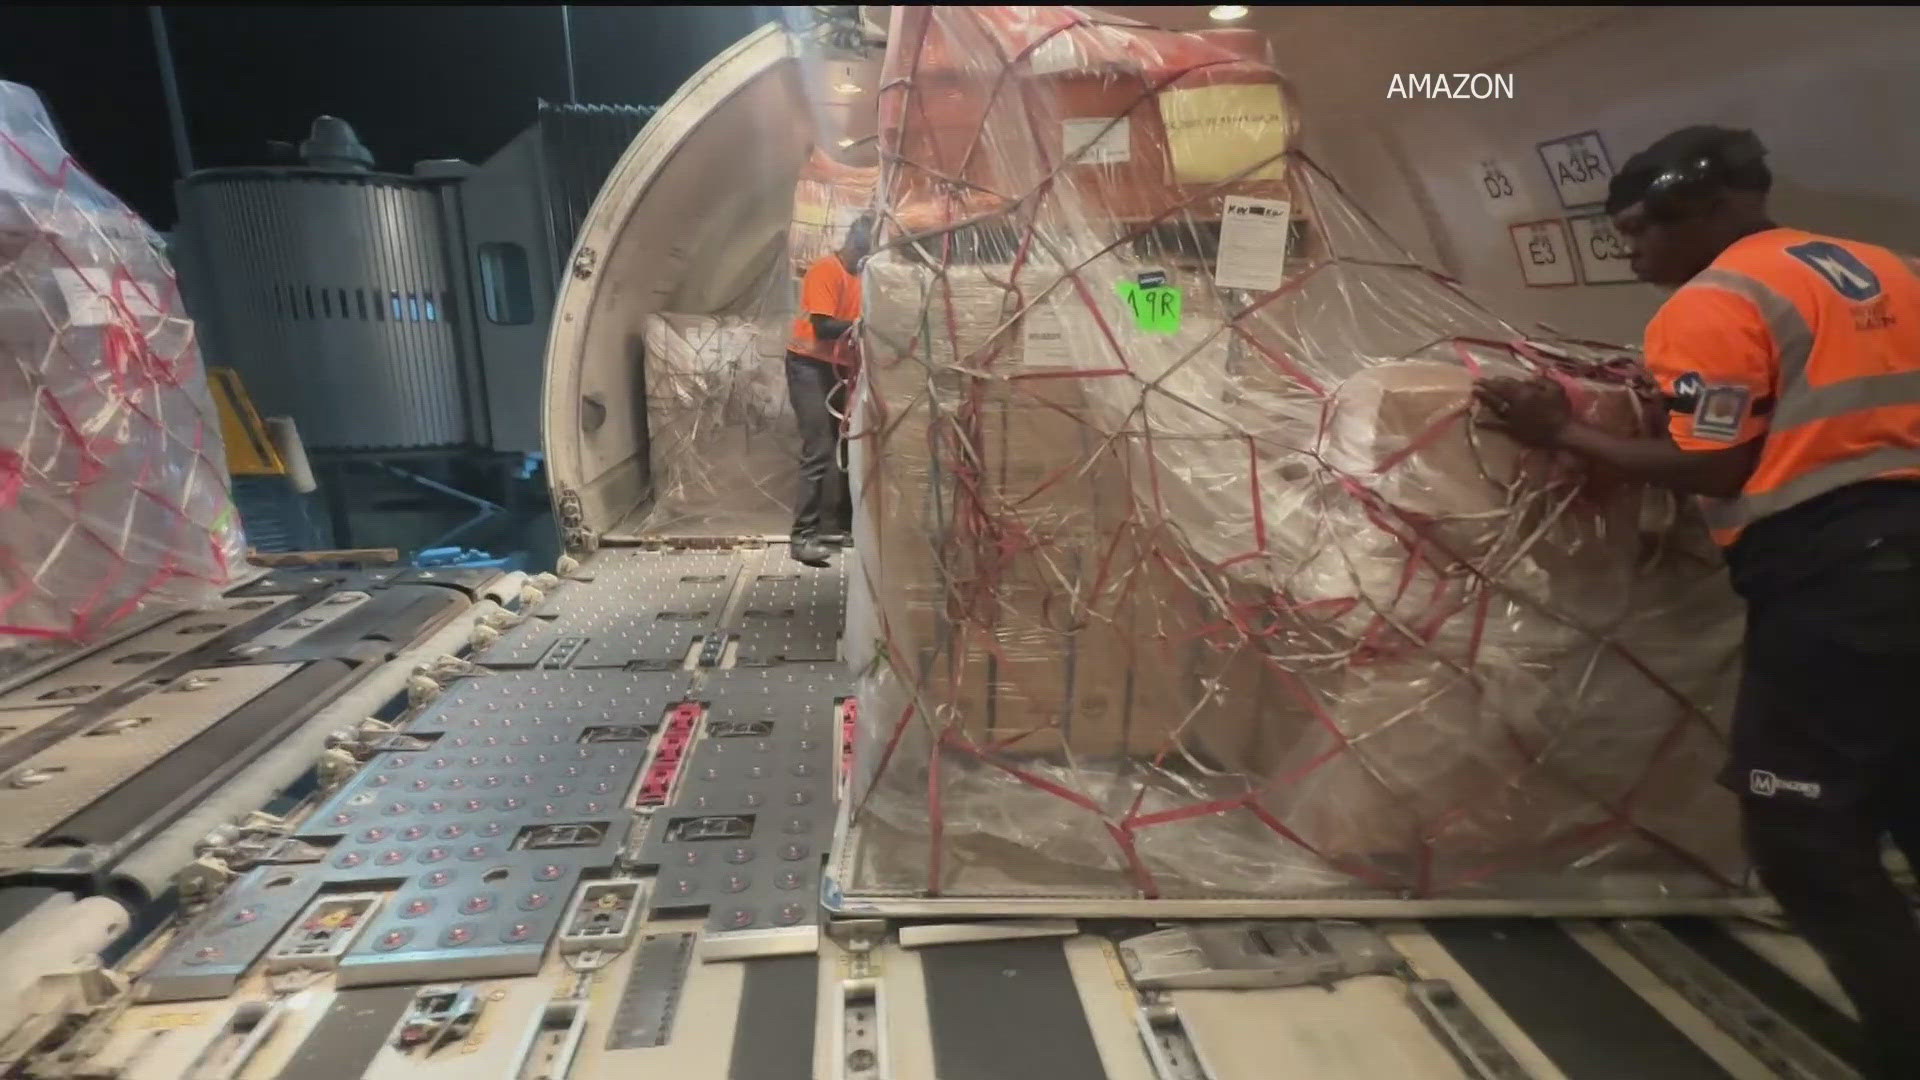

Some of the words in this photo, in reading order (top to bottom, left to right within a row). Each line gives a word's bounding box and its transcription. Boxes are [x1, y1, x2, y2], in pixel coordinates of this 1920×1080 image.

[1558, 154, 1607, 186] A3R
[1484, 174, 1513, 198] D3
[1529, 239, 1556, 265] E3
[1127, 289, 1176, 322] 19R
